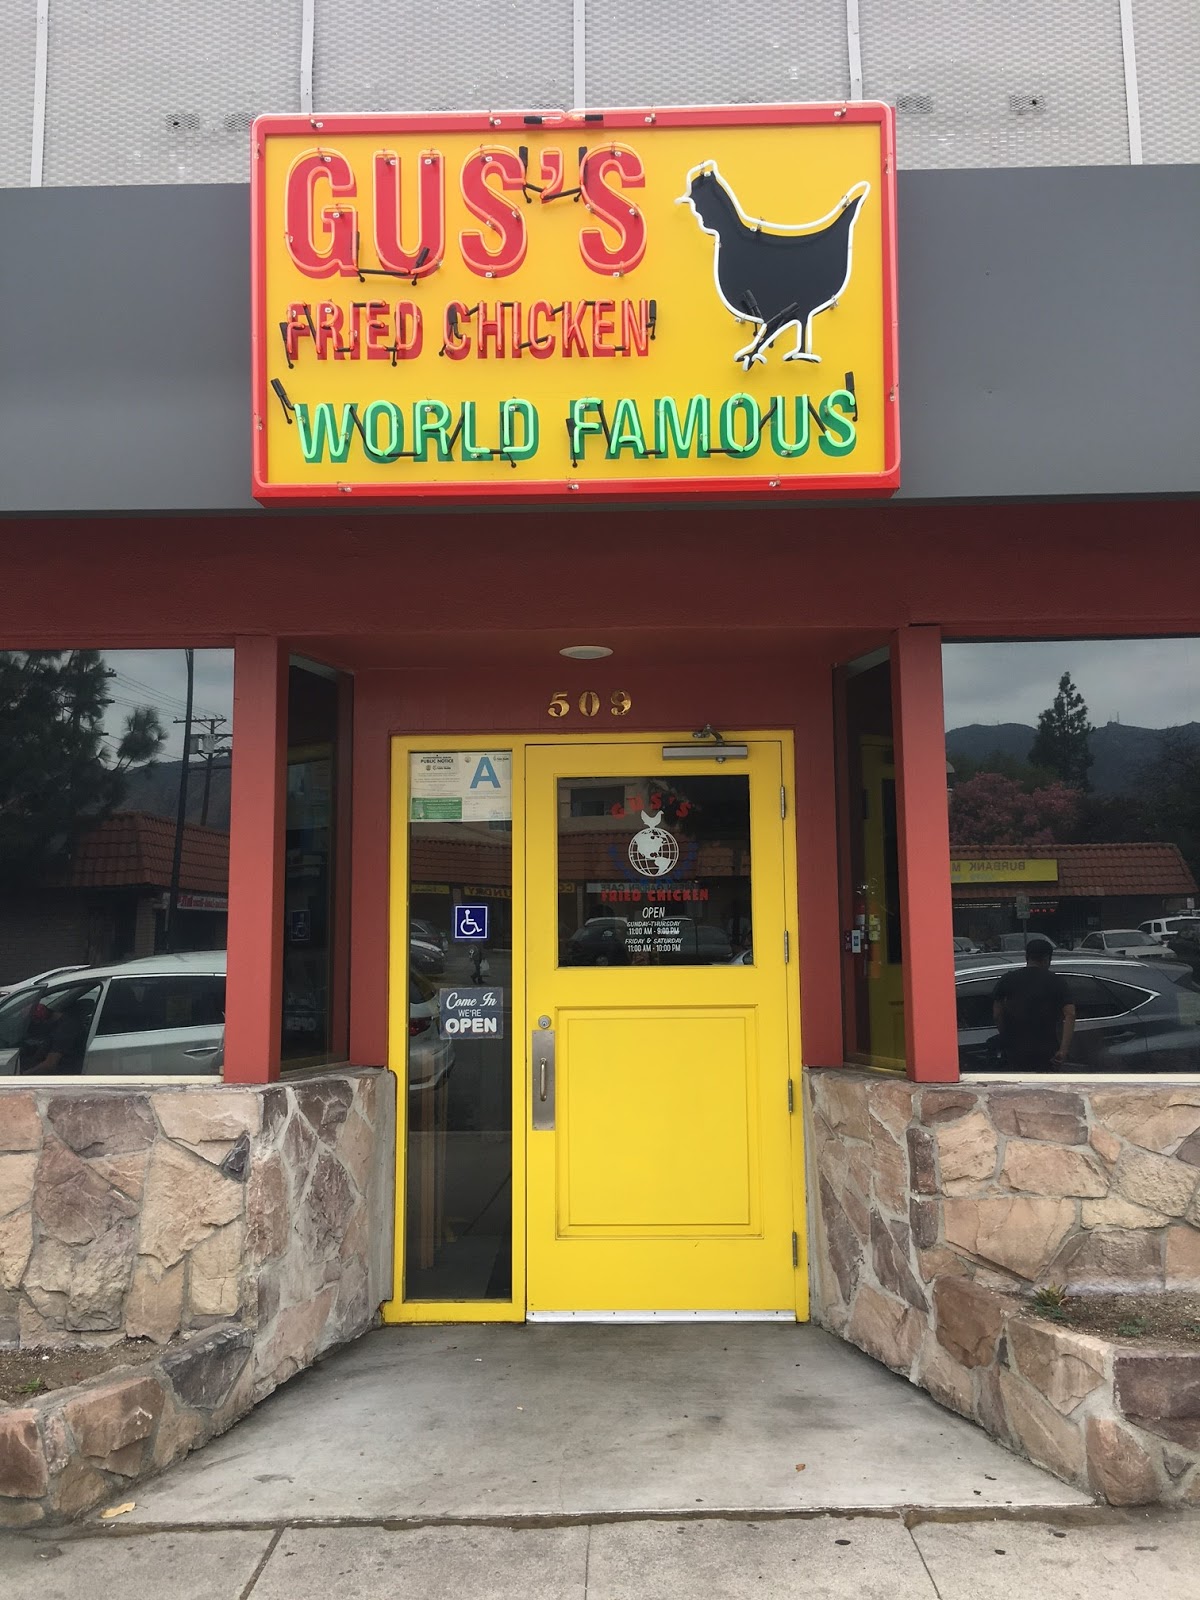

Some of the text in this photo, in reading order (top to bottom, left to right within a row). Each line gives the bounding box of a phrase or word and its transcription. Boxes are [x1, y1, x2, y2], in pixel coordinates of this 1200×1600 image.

[285, 141, 648, 279] GUS'S
[286, 300, 653, 361] FRIED CHICKEN
[293, 389, 858, 464] WORLD FAMOUS
[547, 690, 632, 717] 509
[470, 756, 501, 789] A
[611, 792, 691, 819] GUS'S
[601, 888, 709, 902] FRIED CHICKEN
[642, 907, 665, 918] OPEN
[656, 927, 670, 935] 9:00
[670, 927, 680, 935] PM
[446, 992, 497, 1010] Come In
[458, 1009, 481, 1017] WE'RE
[445, 1018, 497, 1033] OPEN
